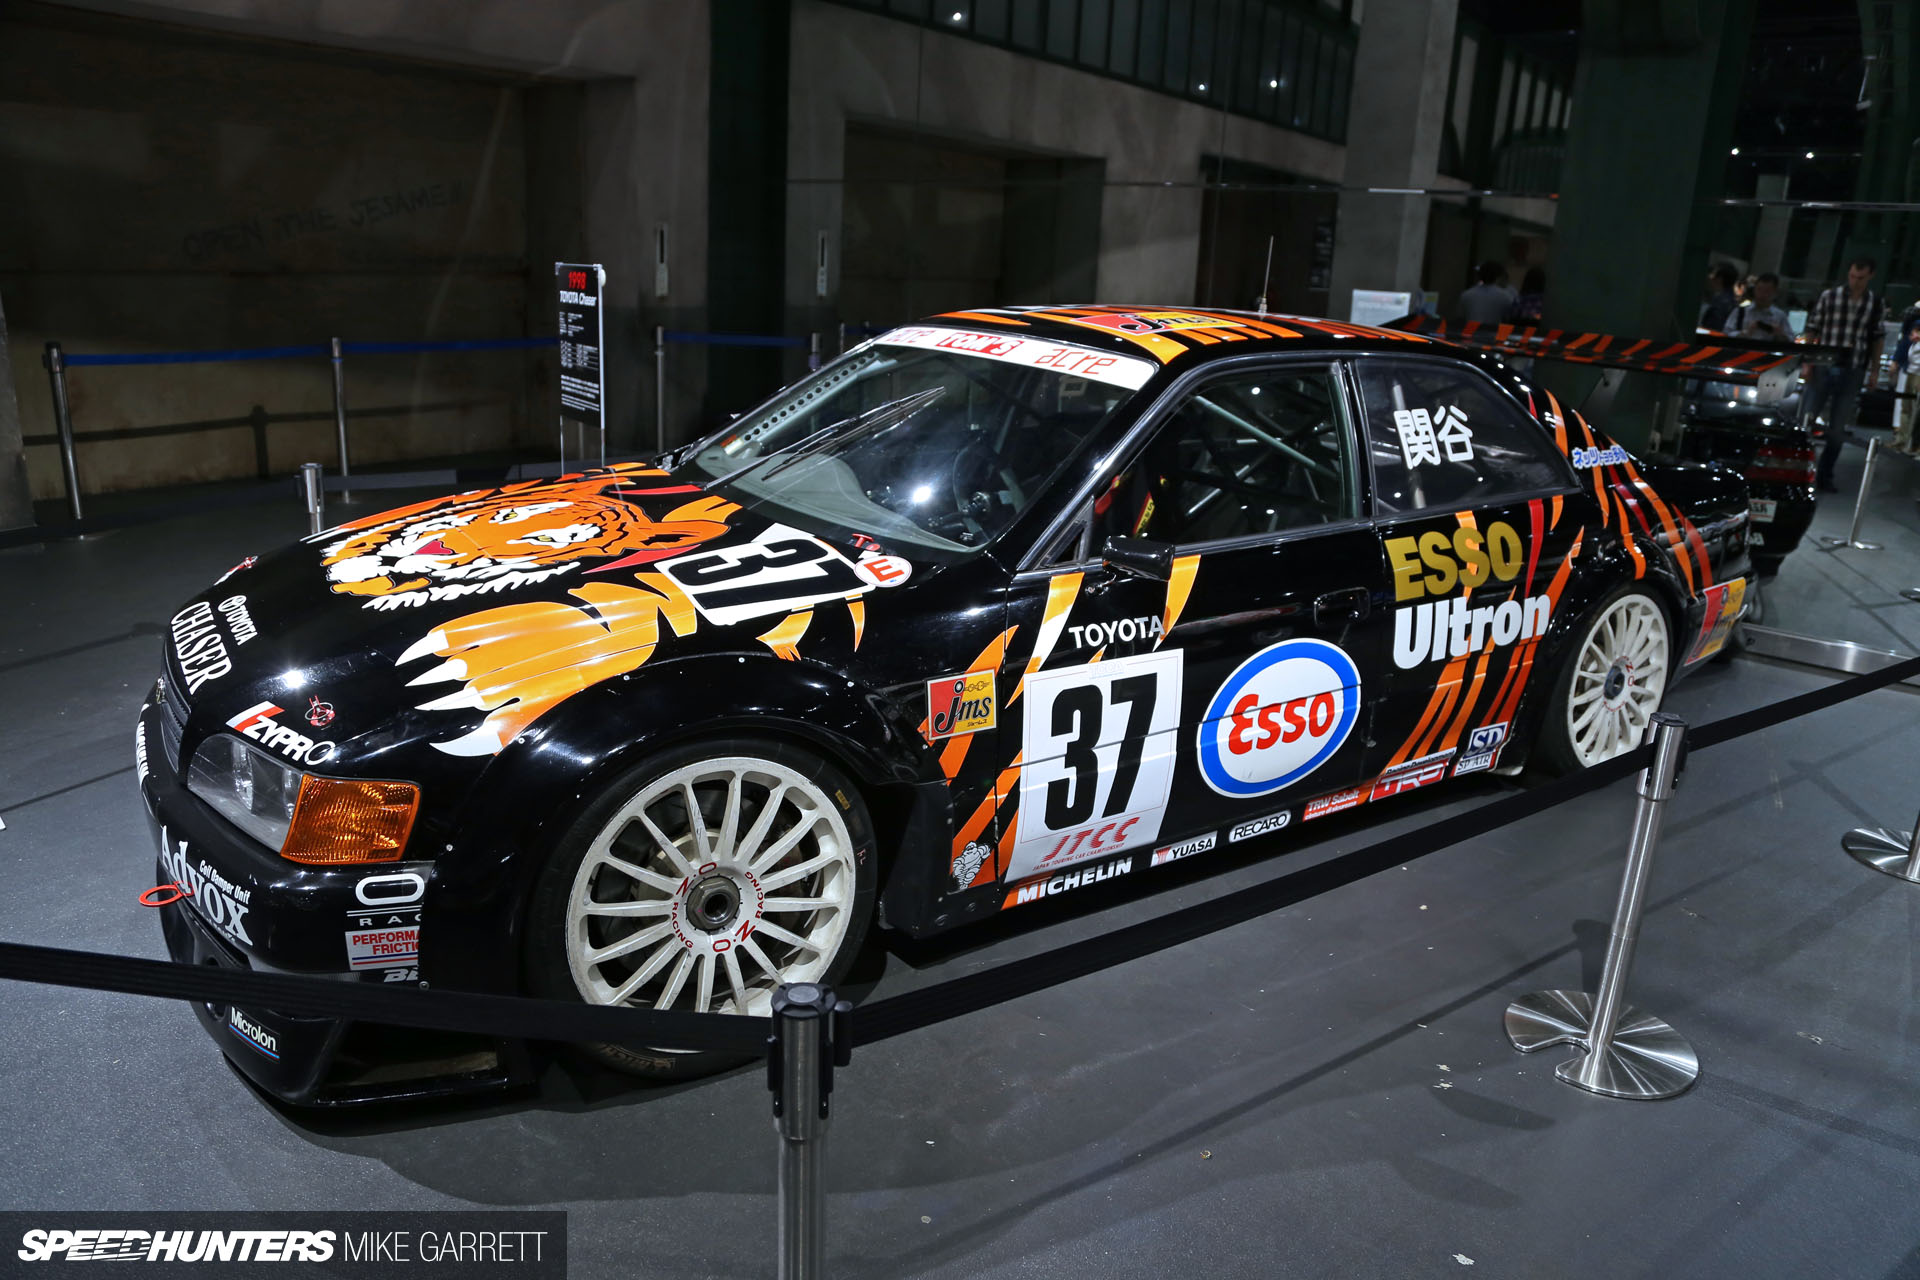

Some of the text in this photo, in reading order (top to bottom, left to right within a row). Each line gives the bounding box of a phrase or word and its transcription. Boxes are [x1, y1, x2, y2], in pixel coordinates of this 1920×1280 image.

[272, 208, 337, 239] THE
[560, 290, 578, 304] TOYOTA
[568, 271, 587, 290] 1998
[1393, 405, 1474, 469] 関谷
[668, 538, 869, 610] 37
[1384, 521, 1523, 602] ESSO
[225, 604, 258, 646] TOYOTA
[1069, 615, 1165, 649] TOYOTA
[1393, 594, 1551, 670] Ultron
[171, 601, 233, 695] CHASER
[241, 715, 337, 766] ZYPRO
[1044, 672, 1158, 831] 37
[1041, 817, 1140, 862] JTCC
[1171, 837, 1213, 860] YUASA
[1233, 813, 1289, 841] RECARO
[1032, 862, 1050, 871] JAPAN
[1052, 856, 1074, 867] TOURING
[1086, 842, 1125, 858] CHAMPIONSHIP
[200, 860, 252, 905] Coil Damper Unit
[744, 871, 764, 919] RACING
[1017, 856, 1133, 905] MICHELIN
[672, 902, 694, 949] RACING
[372, 942, 419, 955] FRICTI
[231, 1006, 278, 1052] Microlon
